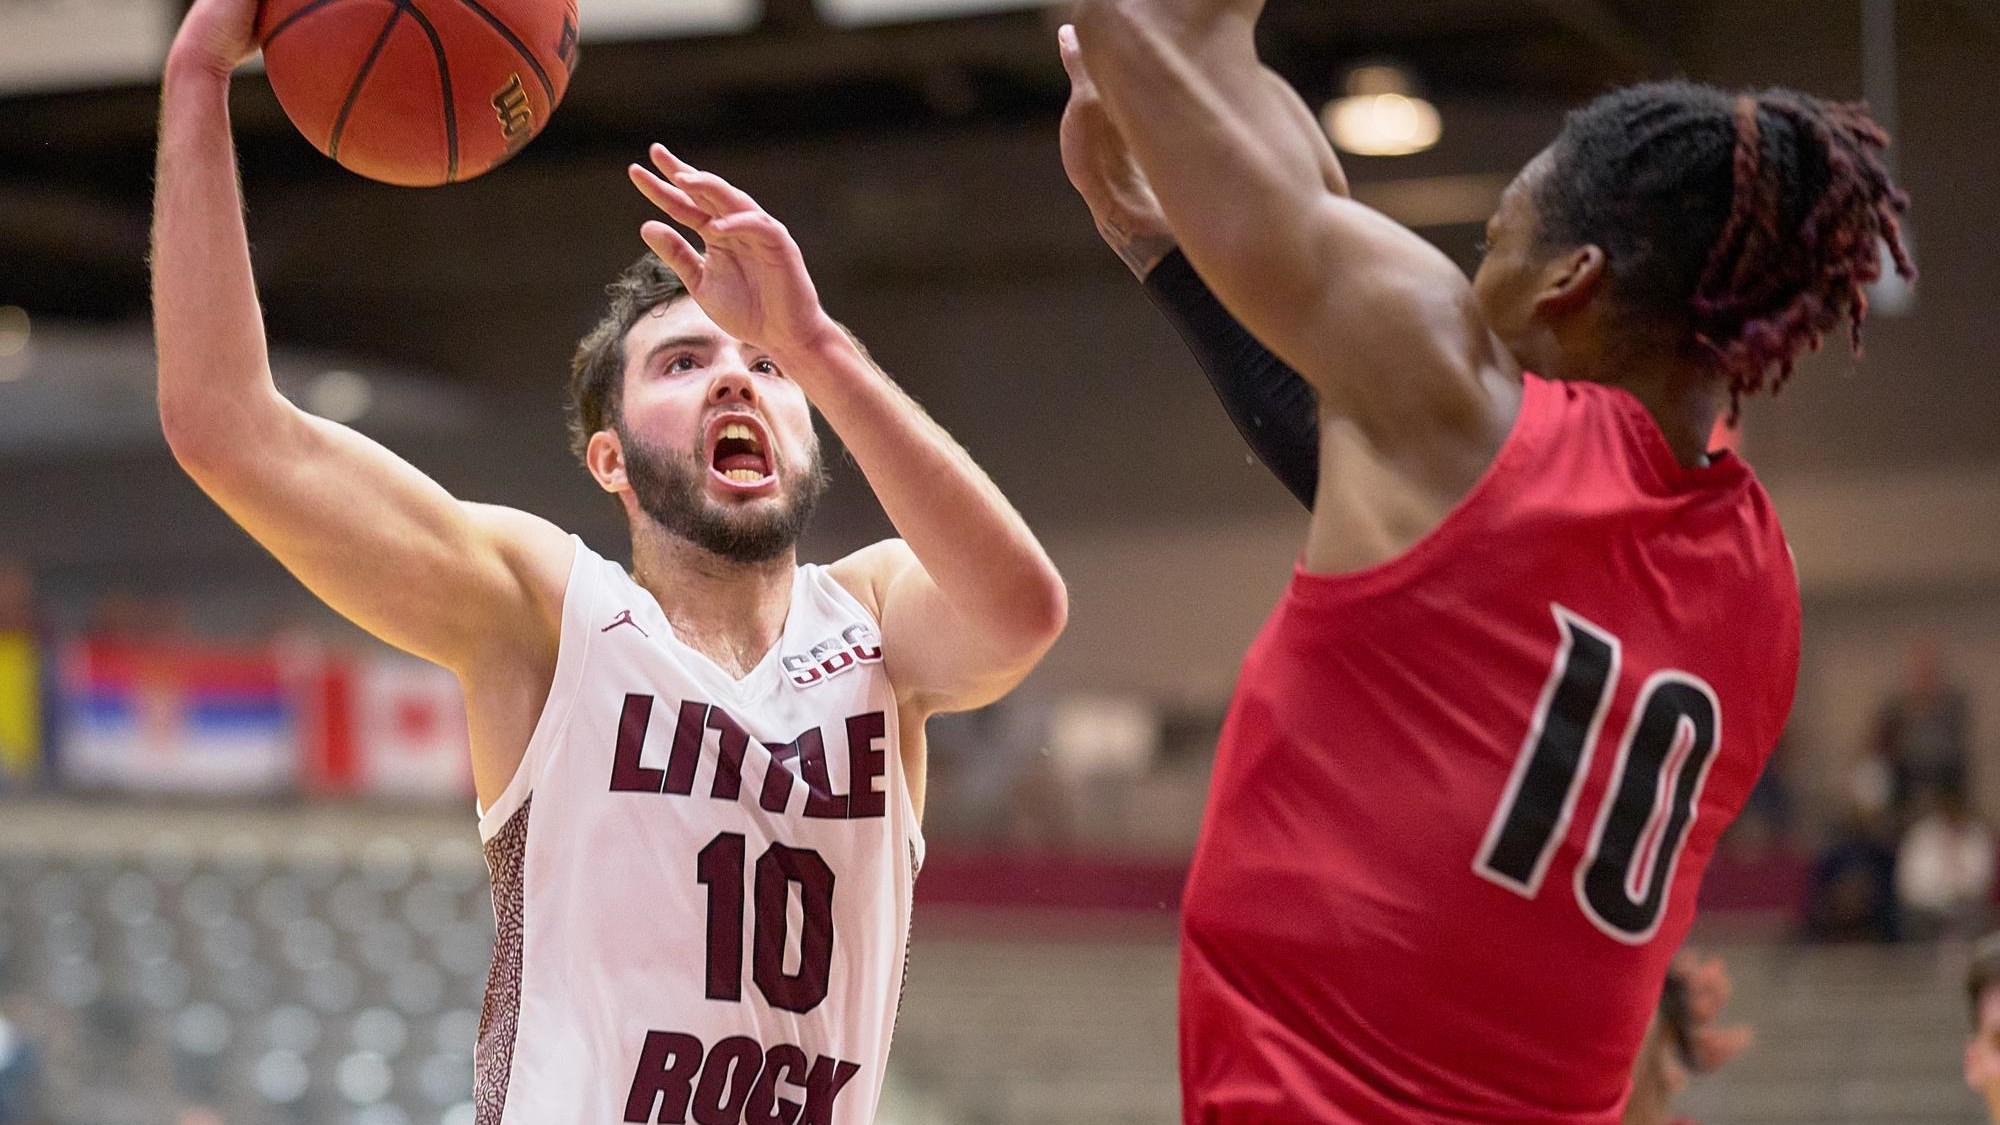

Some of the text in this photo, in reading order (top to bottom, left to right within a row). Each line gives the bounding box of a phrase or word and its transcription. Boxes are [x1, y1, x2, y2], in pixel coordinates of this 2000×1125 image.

[781, 622, 883, 686] SBC
[608, 692, 886, 819] LITTLE
[1471, 602, 1722, 946] 10
[697, 831, 836, 1015] 10
[623, 1029, 862, 1125] ROCK
